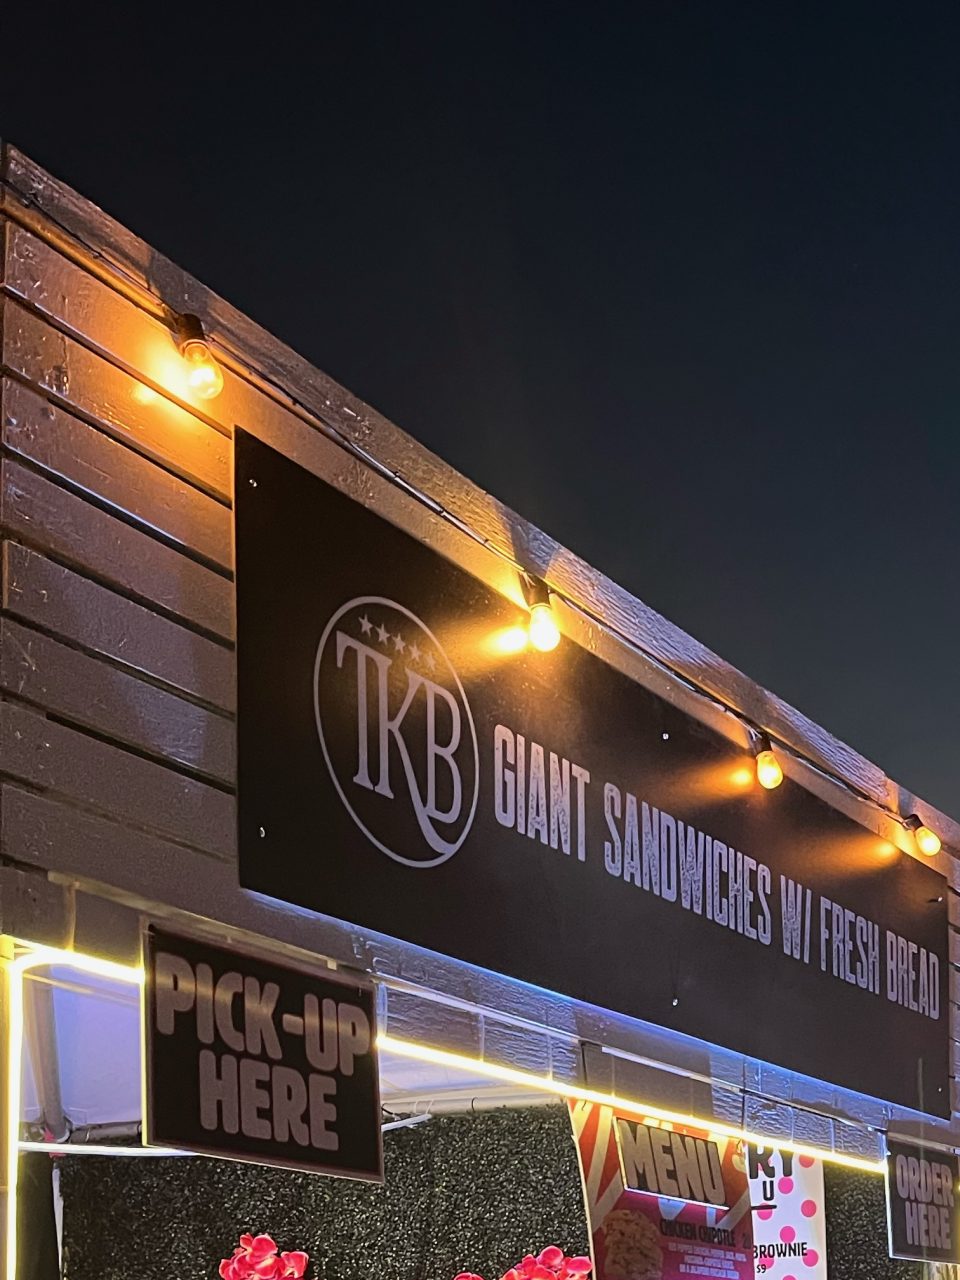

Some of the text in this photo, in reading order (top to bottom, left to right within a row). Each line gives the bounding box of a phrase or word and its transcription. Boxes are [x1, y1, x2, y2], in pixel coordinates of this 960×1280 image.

[336, 630, 462, 854] TKB
[494, 724, 940, 1020] GIANT SANDWICHES W/ FRESH BREAD
[155, 952, 371, 1076] PICK-UP
[200, 1050, 339, 1150] HERE
[618, 1119, 726, 1204] MENU
[896, 1154, 954, 1207] ORDER
[756, 1264, 767, 1274] $9
[905, 1201, 951, 1250] HERE
